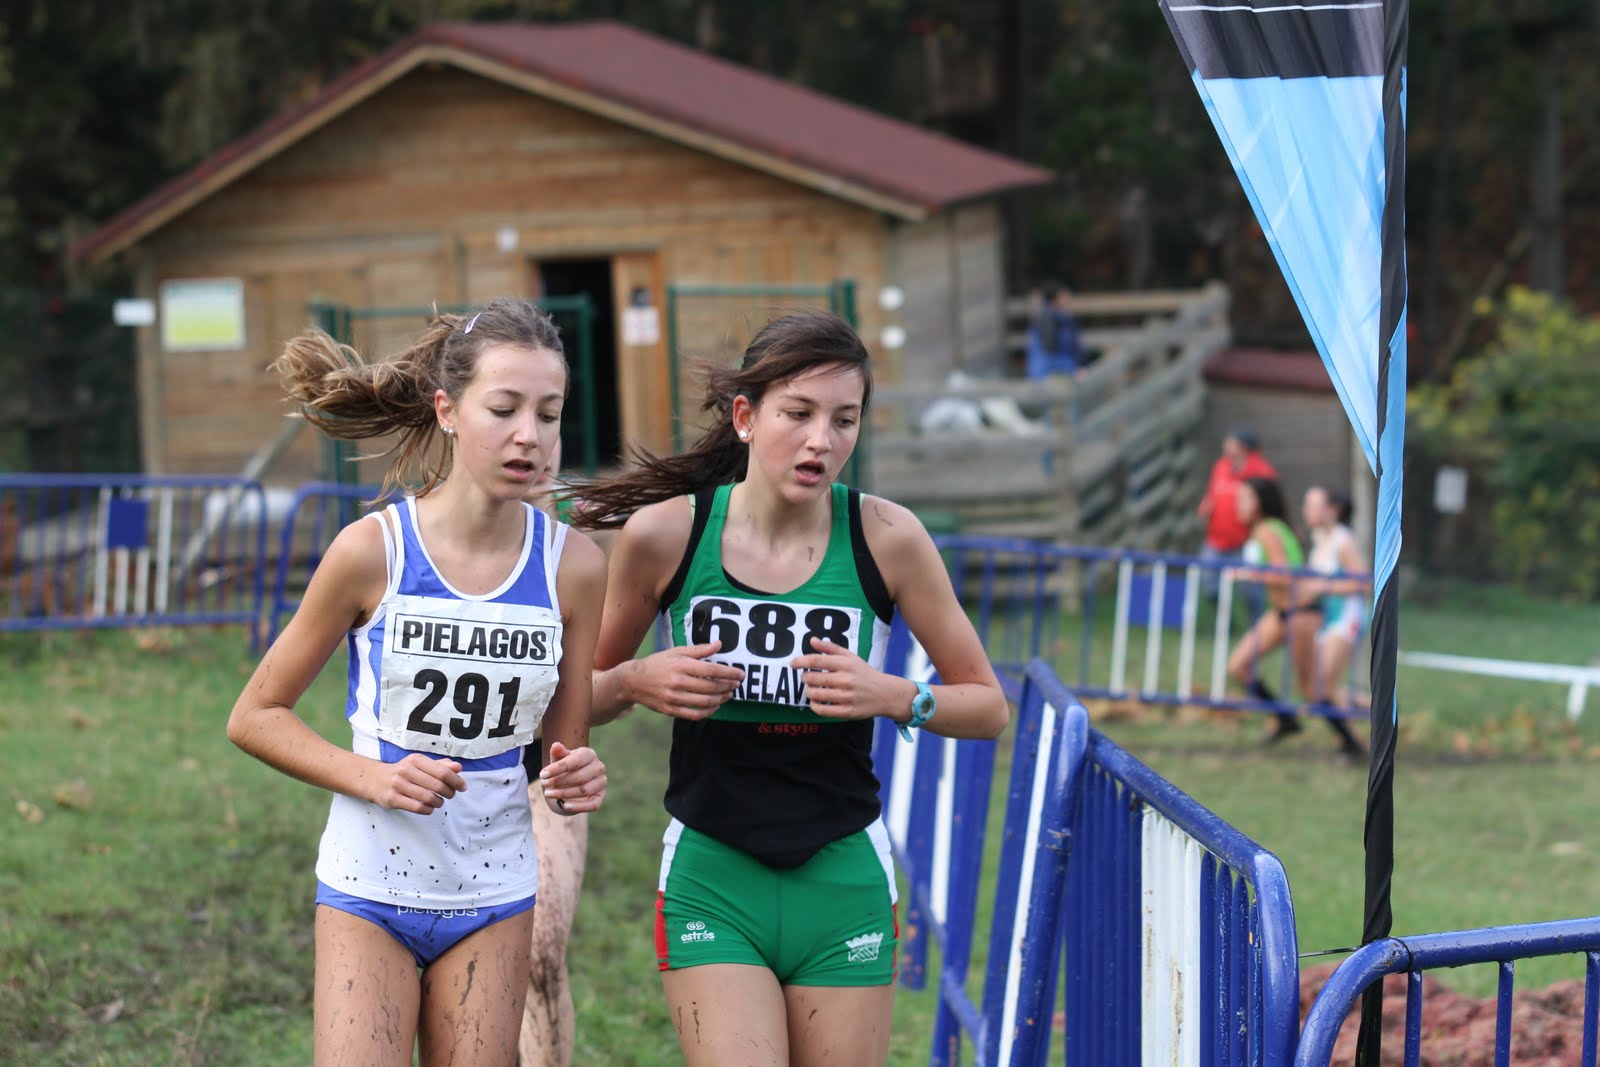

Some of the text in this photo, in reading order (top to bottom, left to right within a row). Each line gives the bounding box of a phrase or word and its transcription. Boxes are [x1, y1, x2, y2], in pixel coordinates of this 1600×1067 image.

[401, 620, 547, 661] PIELAGOS
[691, 598, 851, 659] 688
[407, 669, 521, 739] 291
[757, 722, 819, 737] & style
